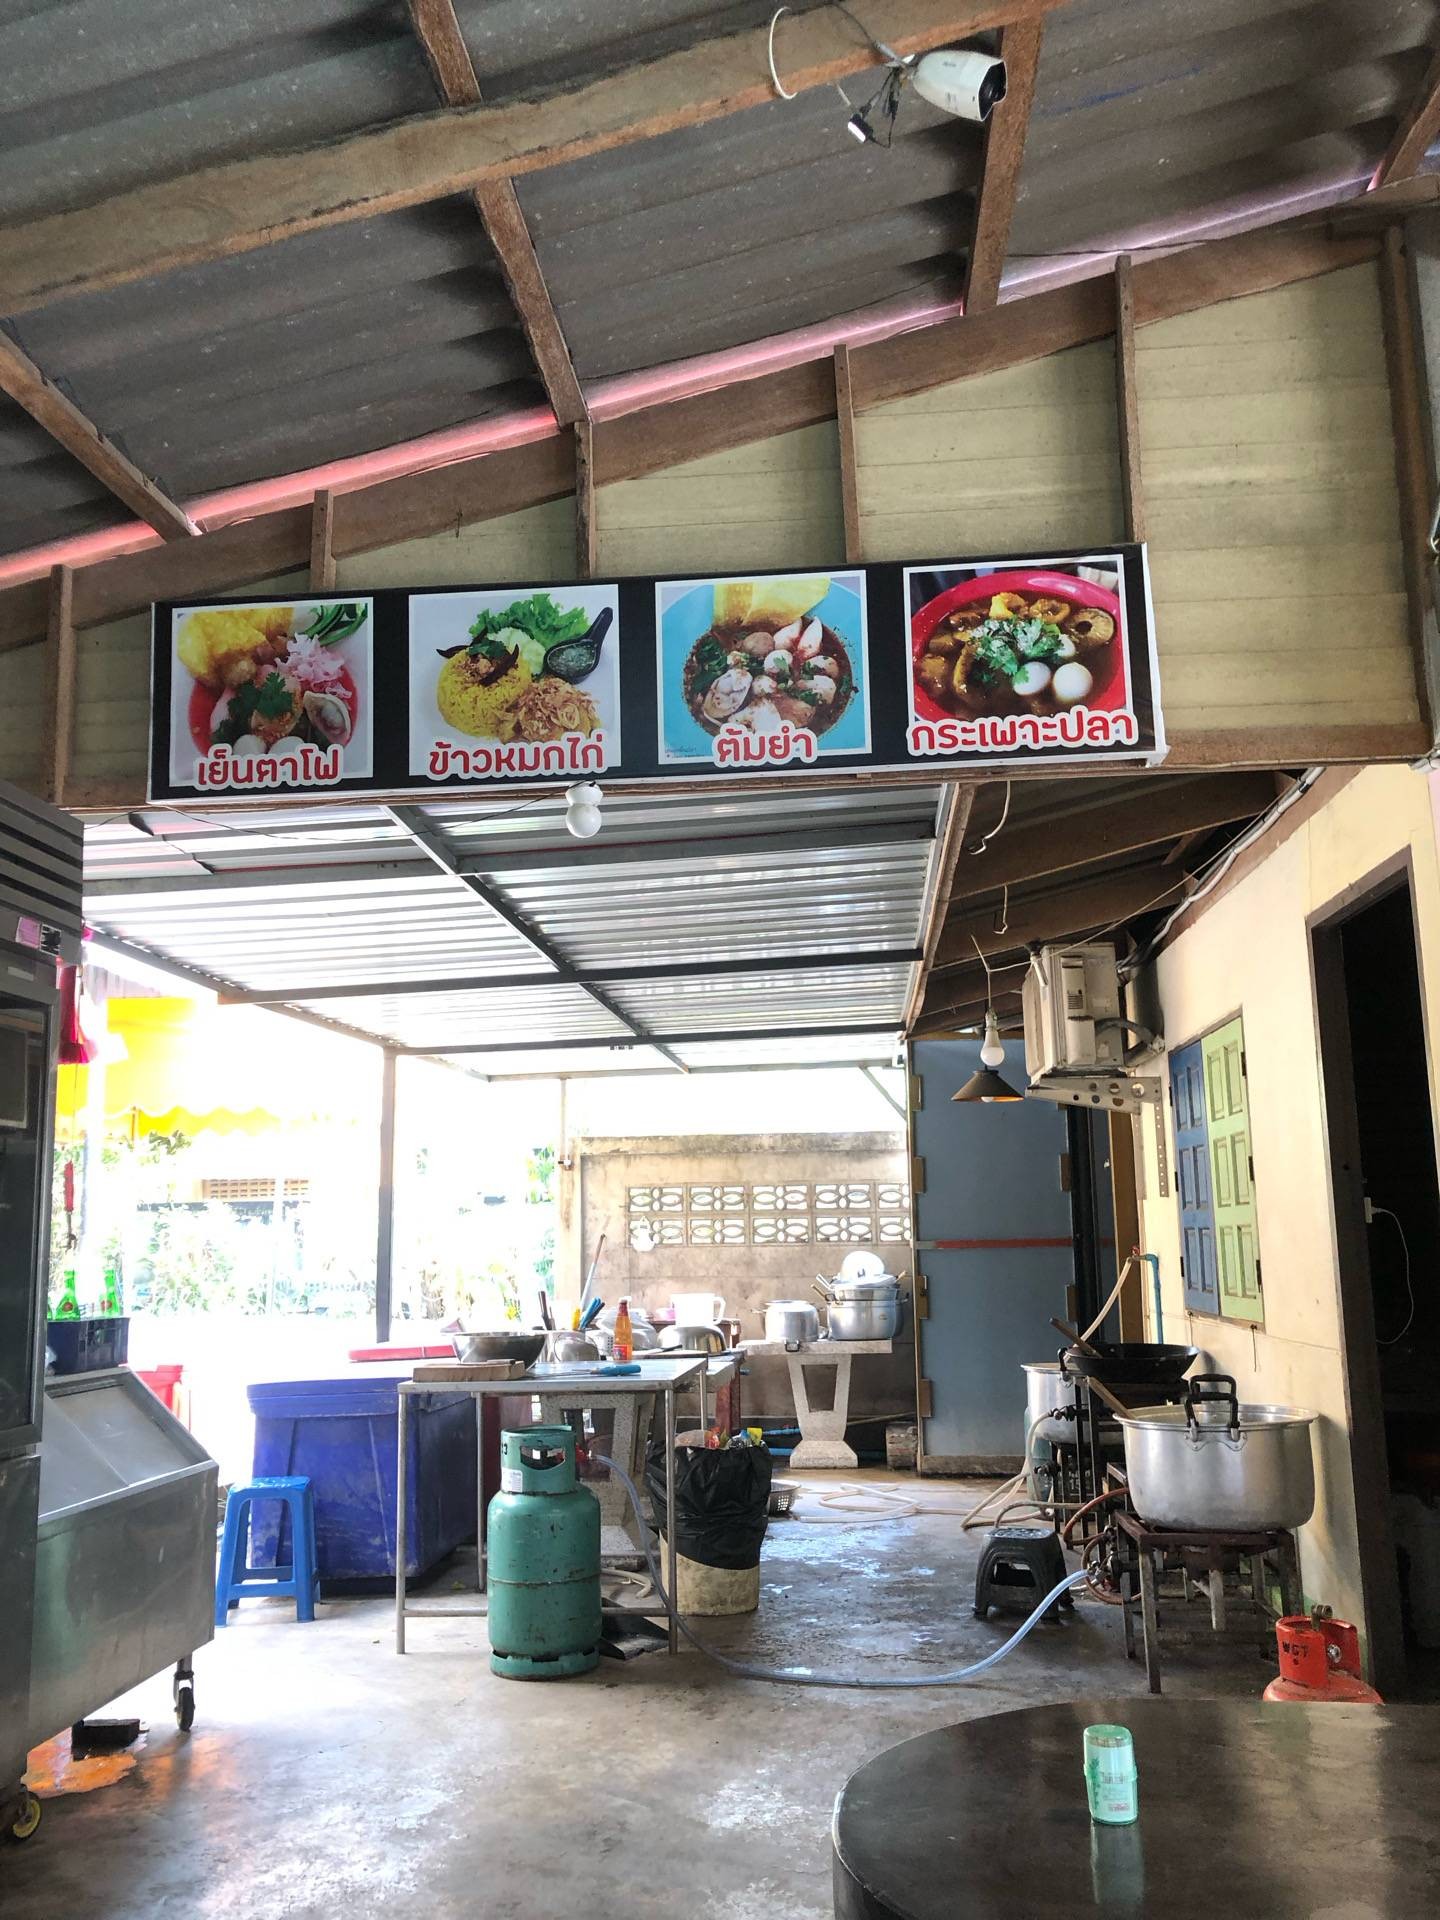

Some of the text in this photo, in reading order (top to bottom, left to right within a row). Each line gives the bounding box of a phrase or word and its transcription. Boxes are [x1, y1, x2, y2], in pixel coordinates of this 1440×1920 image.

[717, 725, 812, 762] ต้มยำ
[911, 710, 1133, 750] กระเพาะปลา
[198, 748, 339, 785] เย็นตาโฟ
[429, 733, 603, 775] ข้าวหมกไก่
